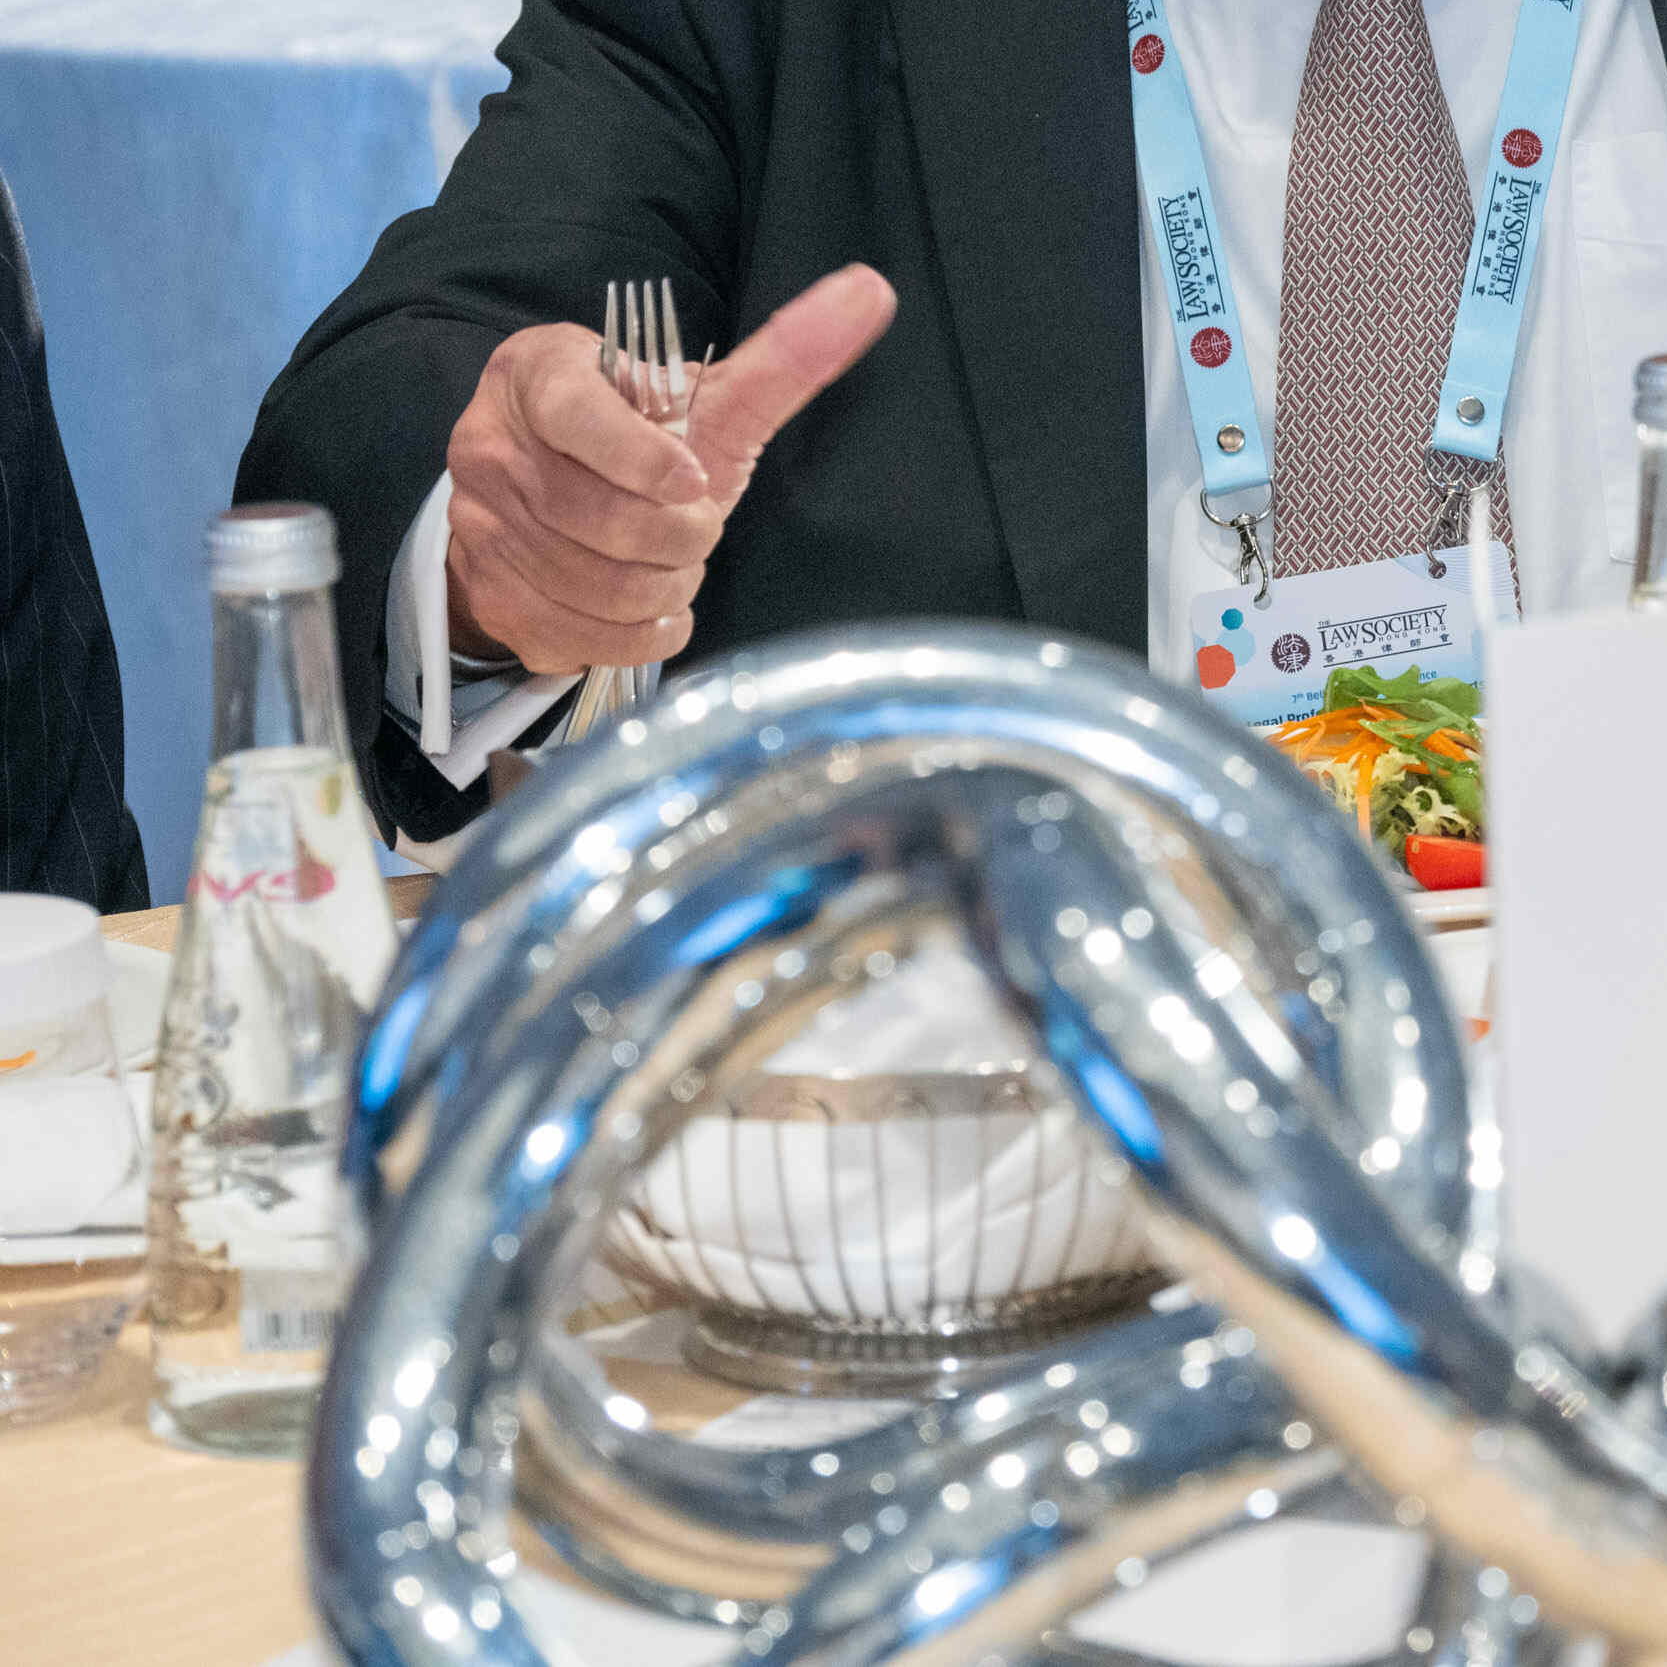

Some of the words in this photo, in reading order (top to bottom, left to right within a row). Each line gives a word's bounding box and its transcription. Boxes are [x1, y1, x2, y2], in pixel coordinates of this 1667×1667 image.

[1345, 640, 1357, 648] OF
[1378, 631, 1409, 642] HONG
[1417, 625, 1447, 635] KONG
